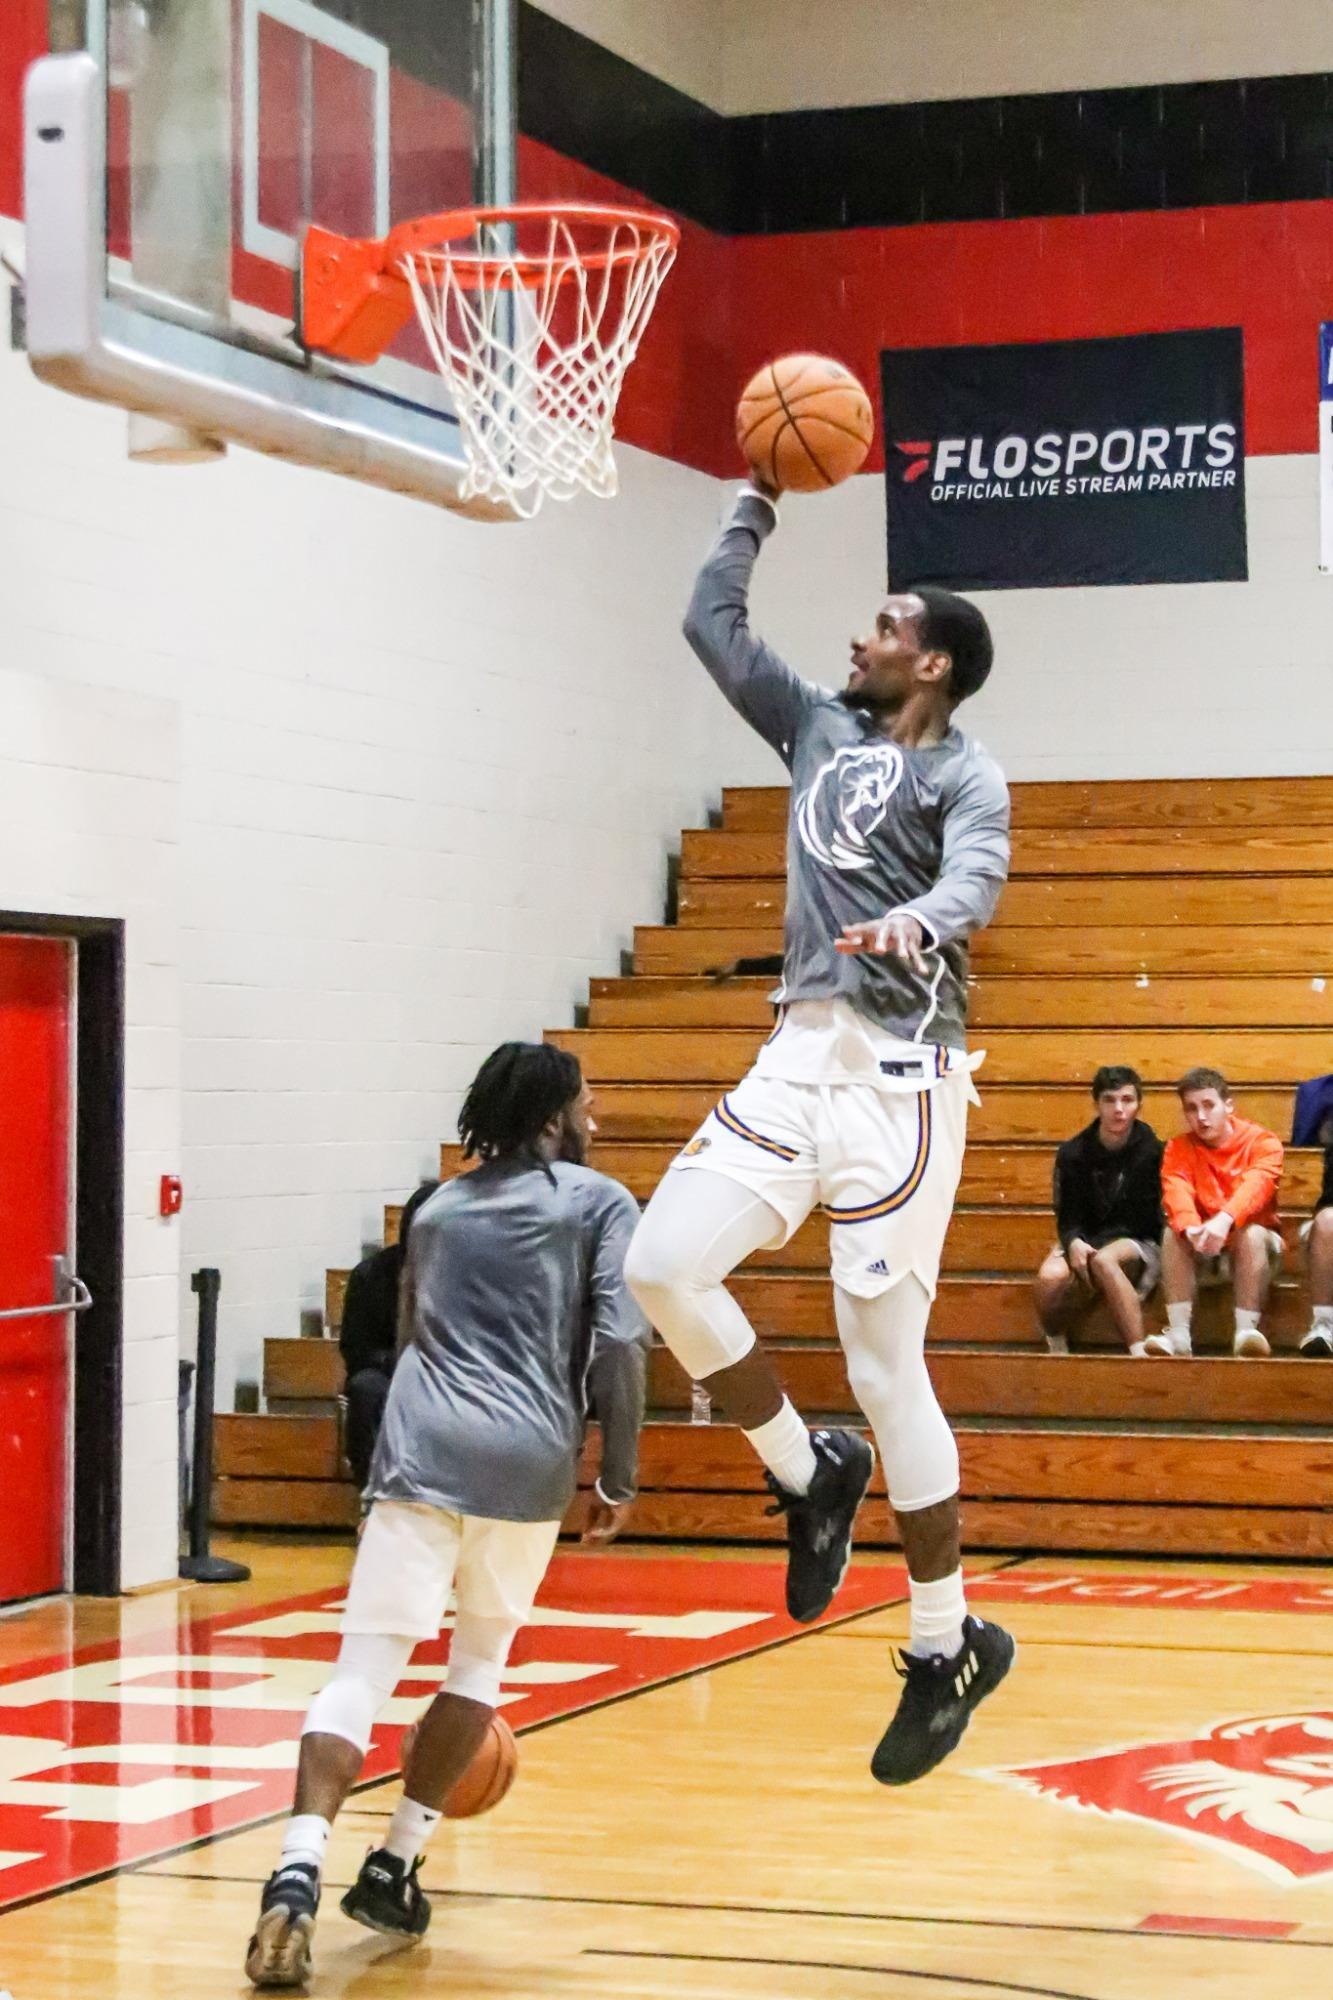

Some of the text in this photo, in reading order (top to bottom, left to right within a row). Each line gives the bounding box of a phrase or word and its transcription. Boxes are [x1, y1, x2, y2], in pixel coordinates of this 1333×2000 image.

[933, 422, 1237, 482] FLOSPORTS
[930, 469, 1237, 501] OFFICIAL LIVE STREAM PARTNER
